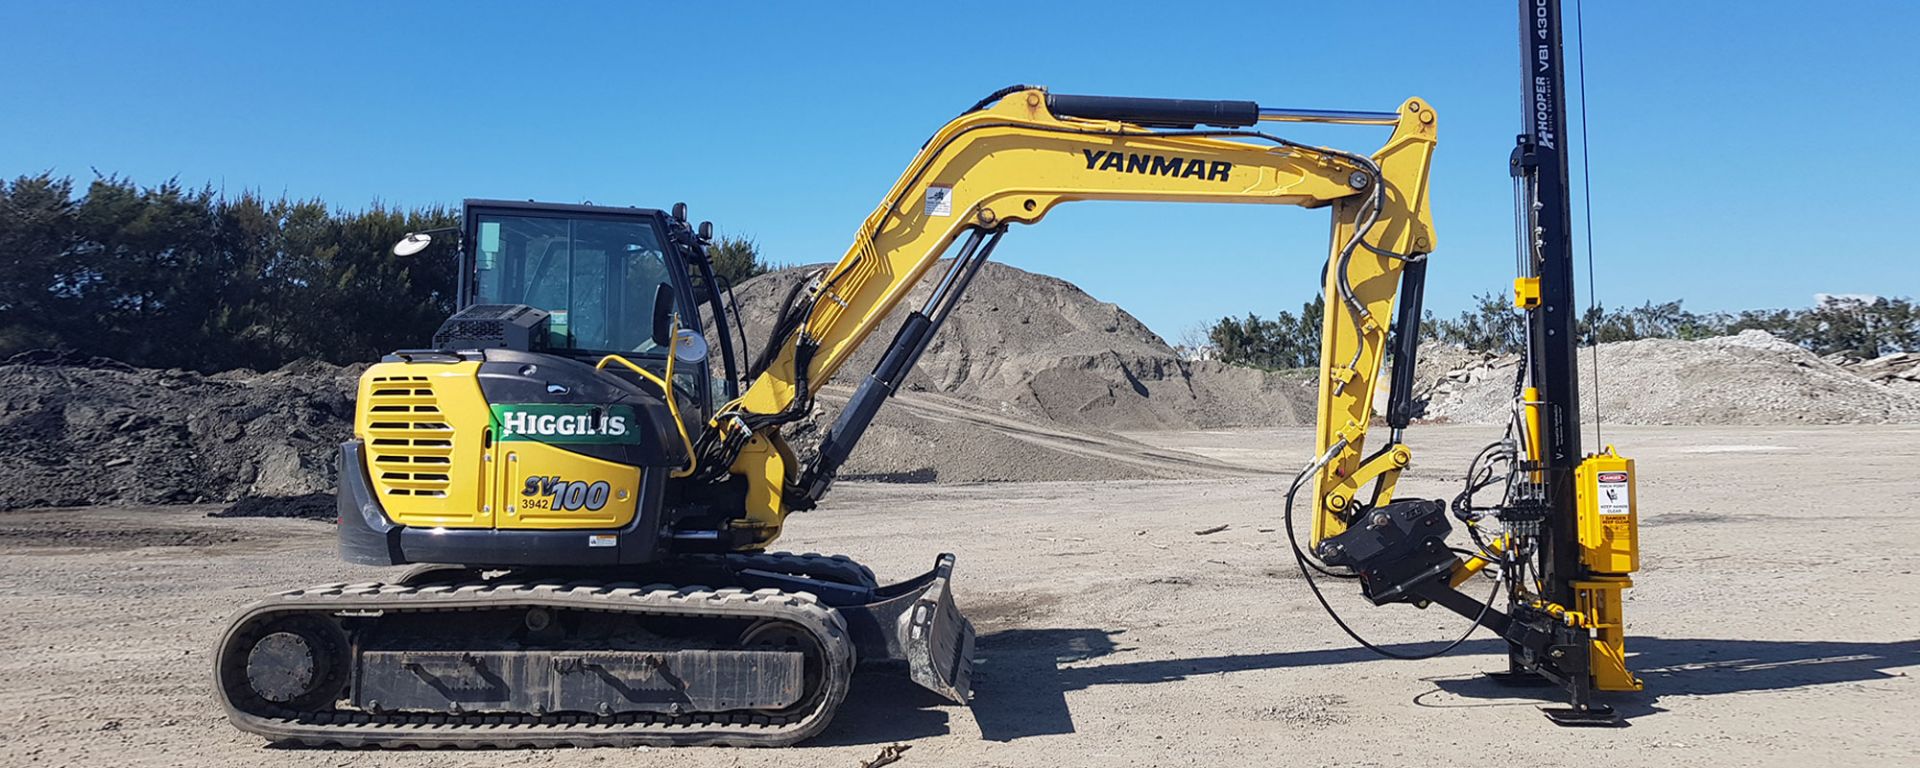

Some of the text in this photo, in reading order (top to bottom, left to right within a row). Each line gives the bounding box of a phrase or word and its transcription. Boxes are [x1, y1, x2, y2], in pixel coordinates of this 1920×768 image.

[1538, 45, 1550, 72] VBI
[1536, 76, 1548, 131] HOOPER
[1083, 149, 1232, 182] YANMAR
[522, 499, 549, 510] 3942
